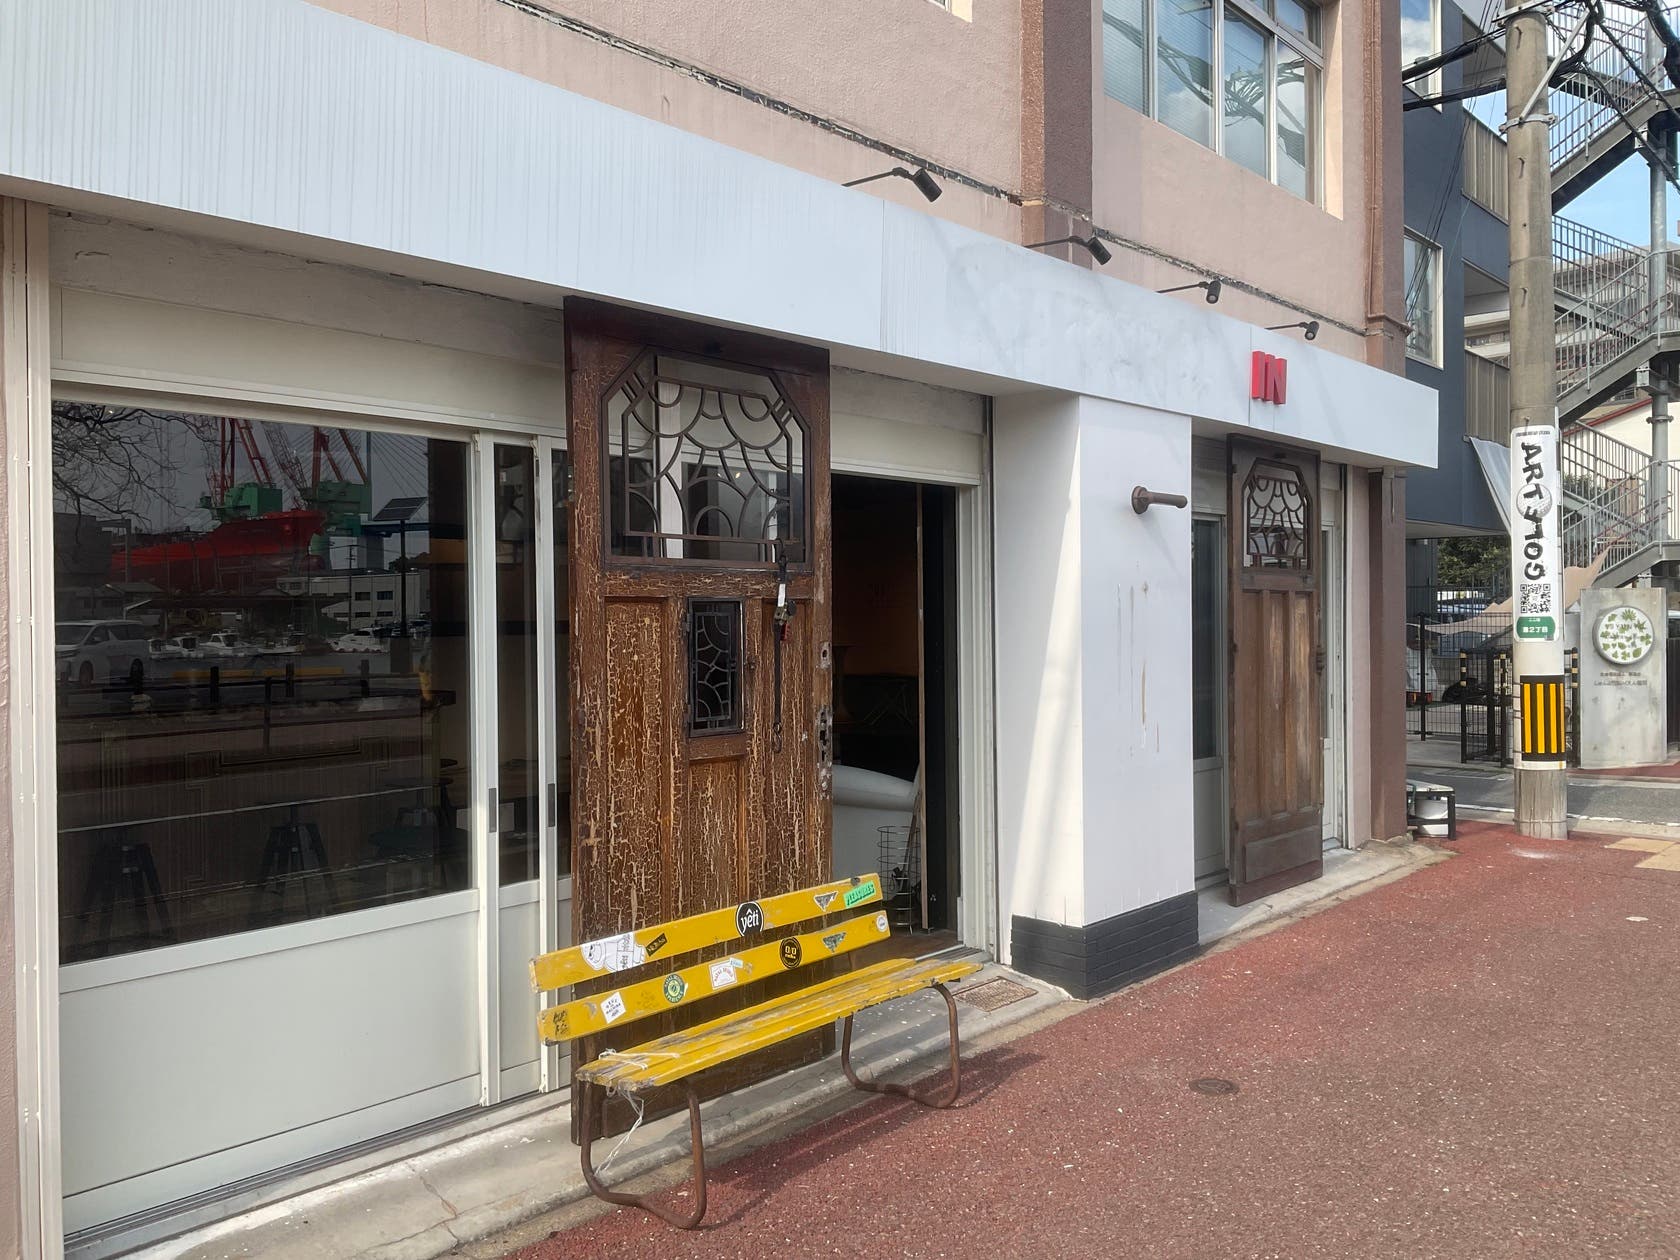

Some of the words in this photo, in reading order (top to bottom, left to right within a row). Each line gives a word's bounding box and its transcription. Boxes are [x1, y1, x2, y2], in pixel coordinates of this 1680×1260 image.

[1251, 350, 1288, 405] IN
[1520, 442, 1544, 500] ART
[740, 908, 759, 933] yêti
